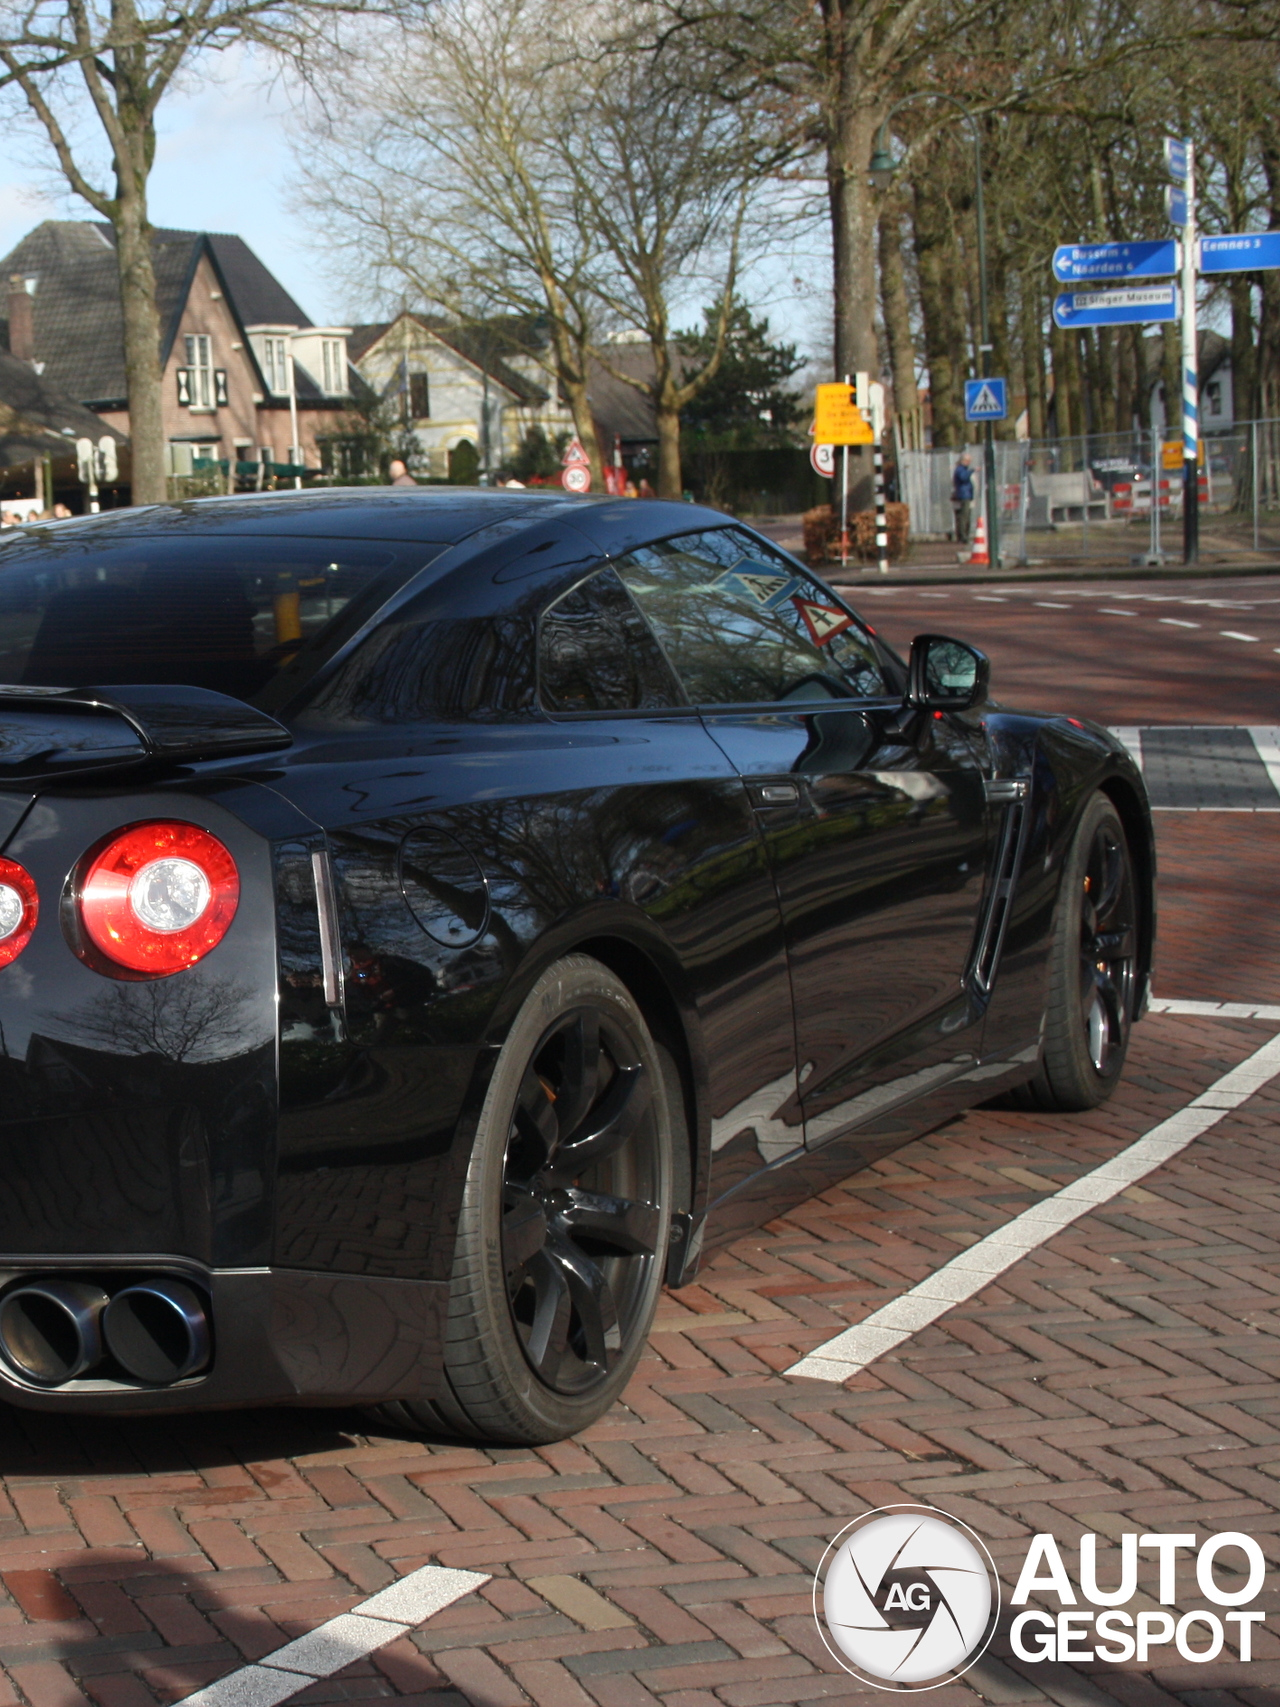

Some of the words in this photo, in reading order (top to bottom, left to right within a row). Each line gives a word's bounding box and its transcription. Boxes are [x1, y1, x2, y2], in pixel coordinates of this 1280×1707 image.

[1202, 239, 1251, 252] Eemnes
[1253, 238, 1261, 249] 3
[1072, 248, 1118, 260] Bussum
[1122, 247, 1130, 257] 4
[1072, 262, 1122, 275] Naarden
[1126, 261, 1134, 272] 6
[1089, 294, 1123, 305] Singer
[1127, 291, 1171, 301] Museum
